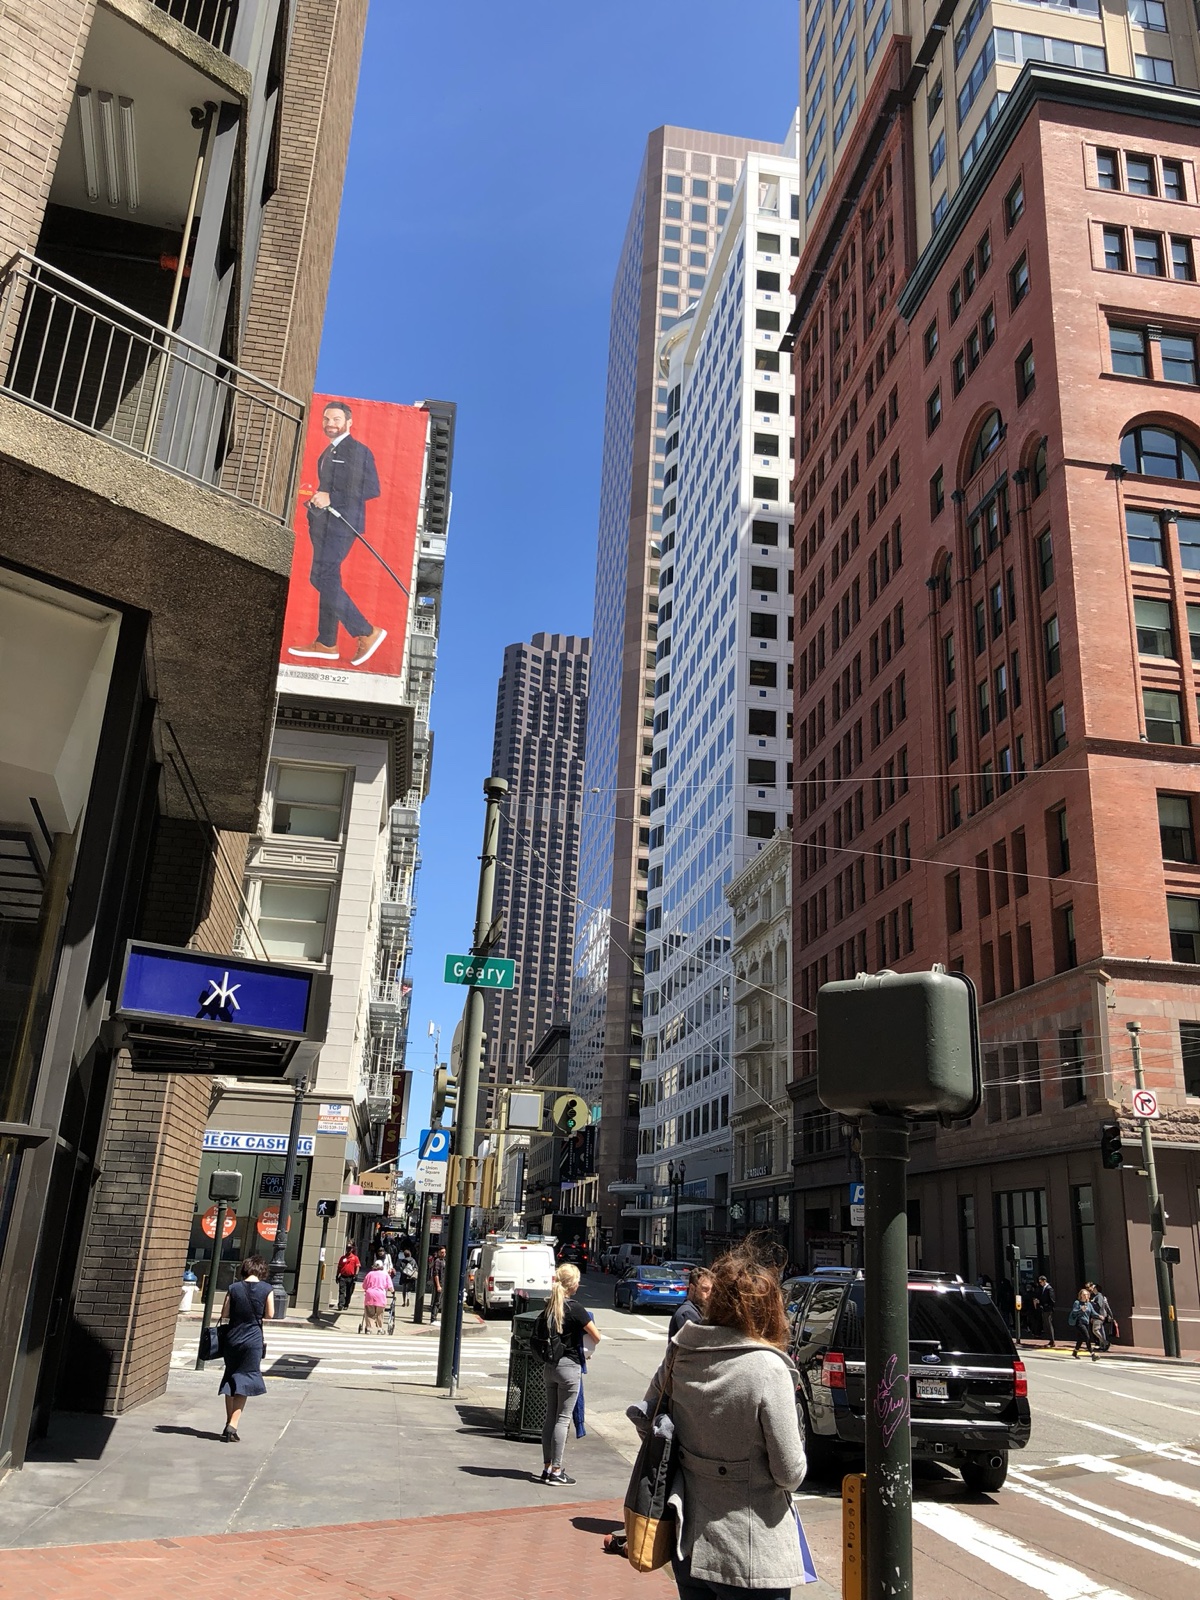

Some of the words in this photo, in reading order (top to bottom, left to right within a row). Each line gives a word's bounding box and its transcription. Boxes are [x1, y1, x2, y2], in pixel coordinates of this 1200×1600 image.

[453, 962, 506, 985] Geary
[203, 1135, 241, 1147] HECK
[245, 1137, 313, 1151] CASHNG
[263, 1211, 280, 1219] Chec
